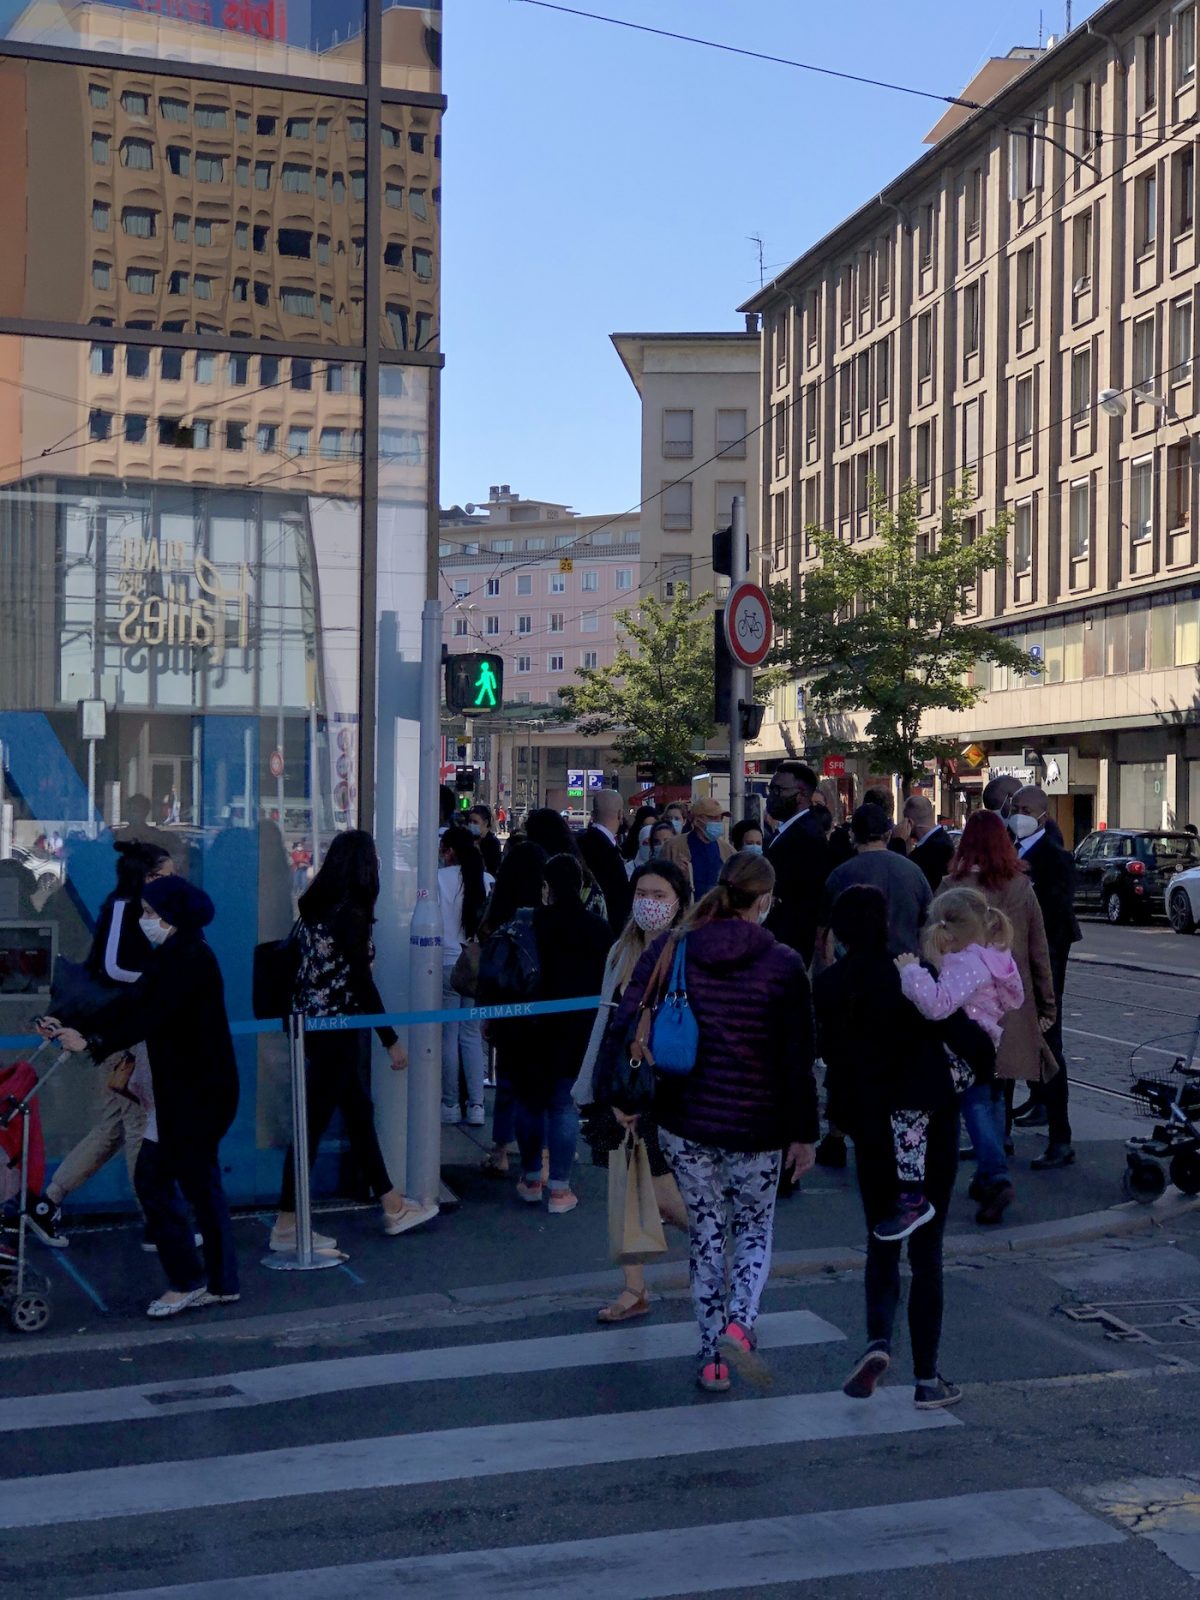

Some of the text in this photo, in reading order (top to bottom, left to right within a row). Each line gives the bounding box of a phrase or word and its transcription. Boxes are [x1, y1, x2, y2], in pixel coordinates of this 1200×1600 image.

[561, 562, 572, 571] 25
[829, 761, 845, 769] SFR
[470, 1004, 533, 1019] PRIMARK
